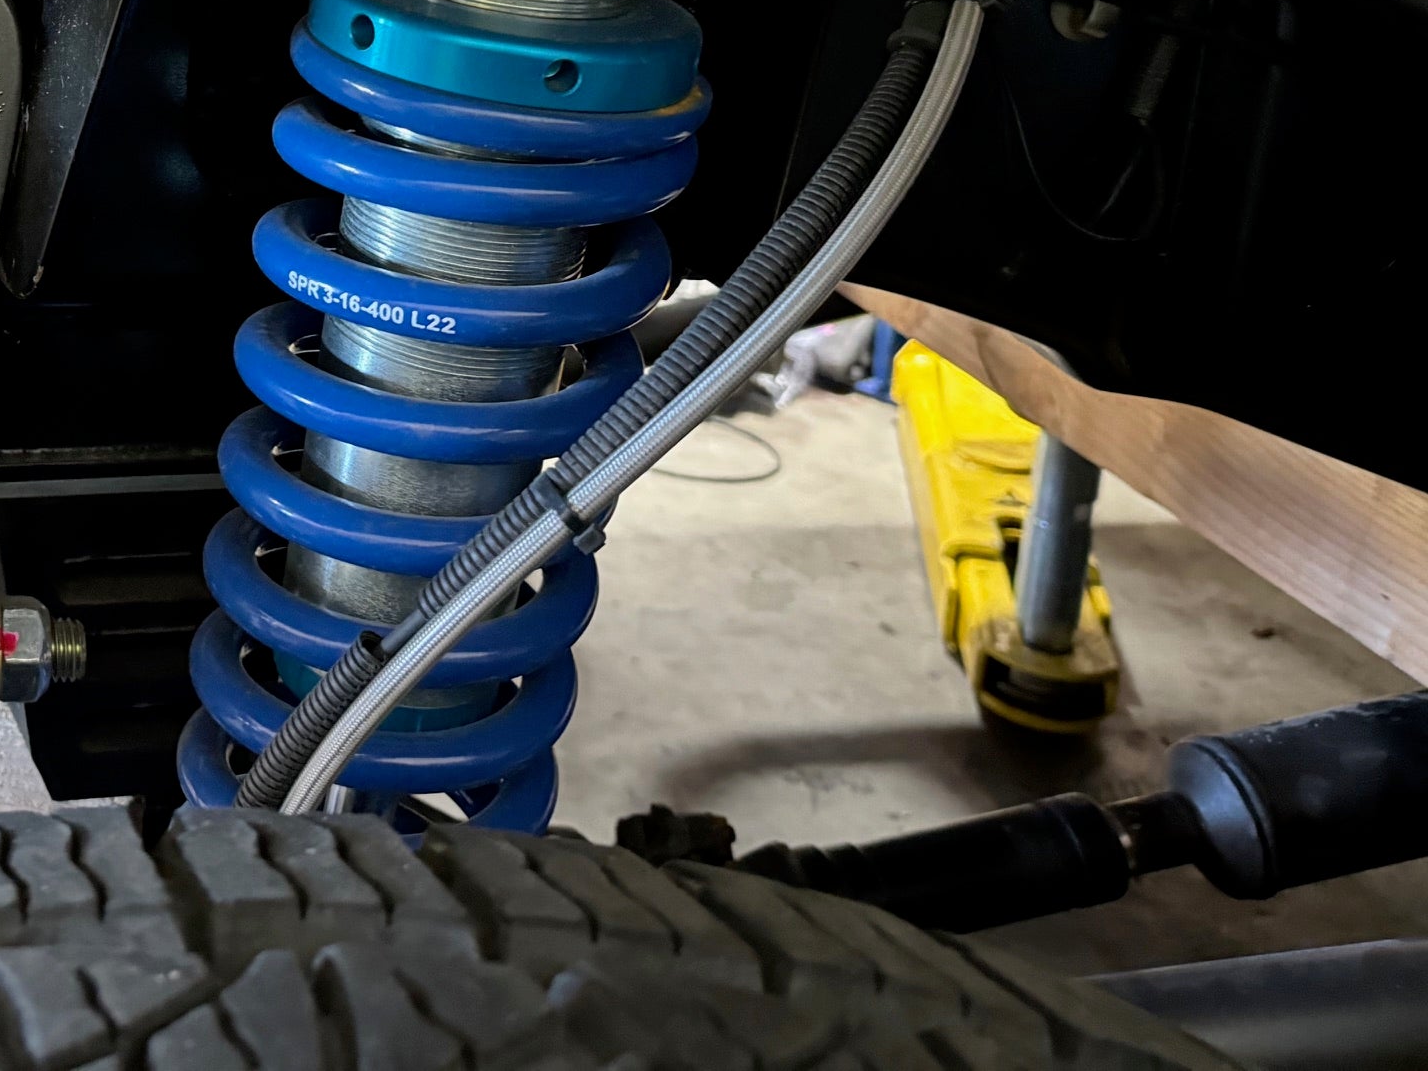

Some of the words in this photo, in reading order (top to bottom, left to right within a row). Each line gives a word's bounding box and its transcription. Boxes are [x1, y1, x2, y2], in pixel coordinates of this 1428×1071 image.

[288, 270, 320, 300] SPR
[323, 286, 404, 325] 3-16-400
[411, 310, 457, 335] L22
